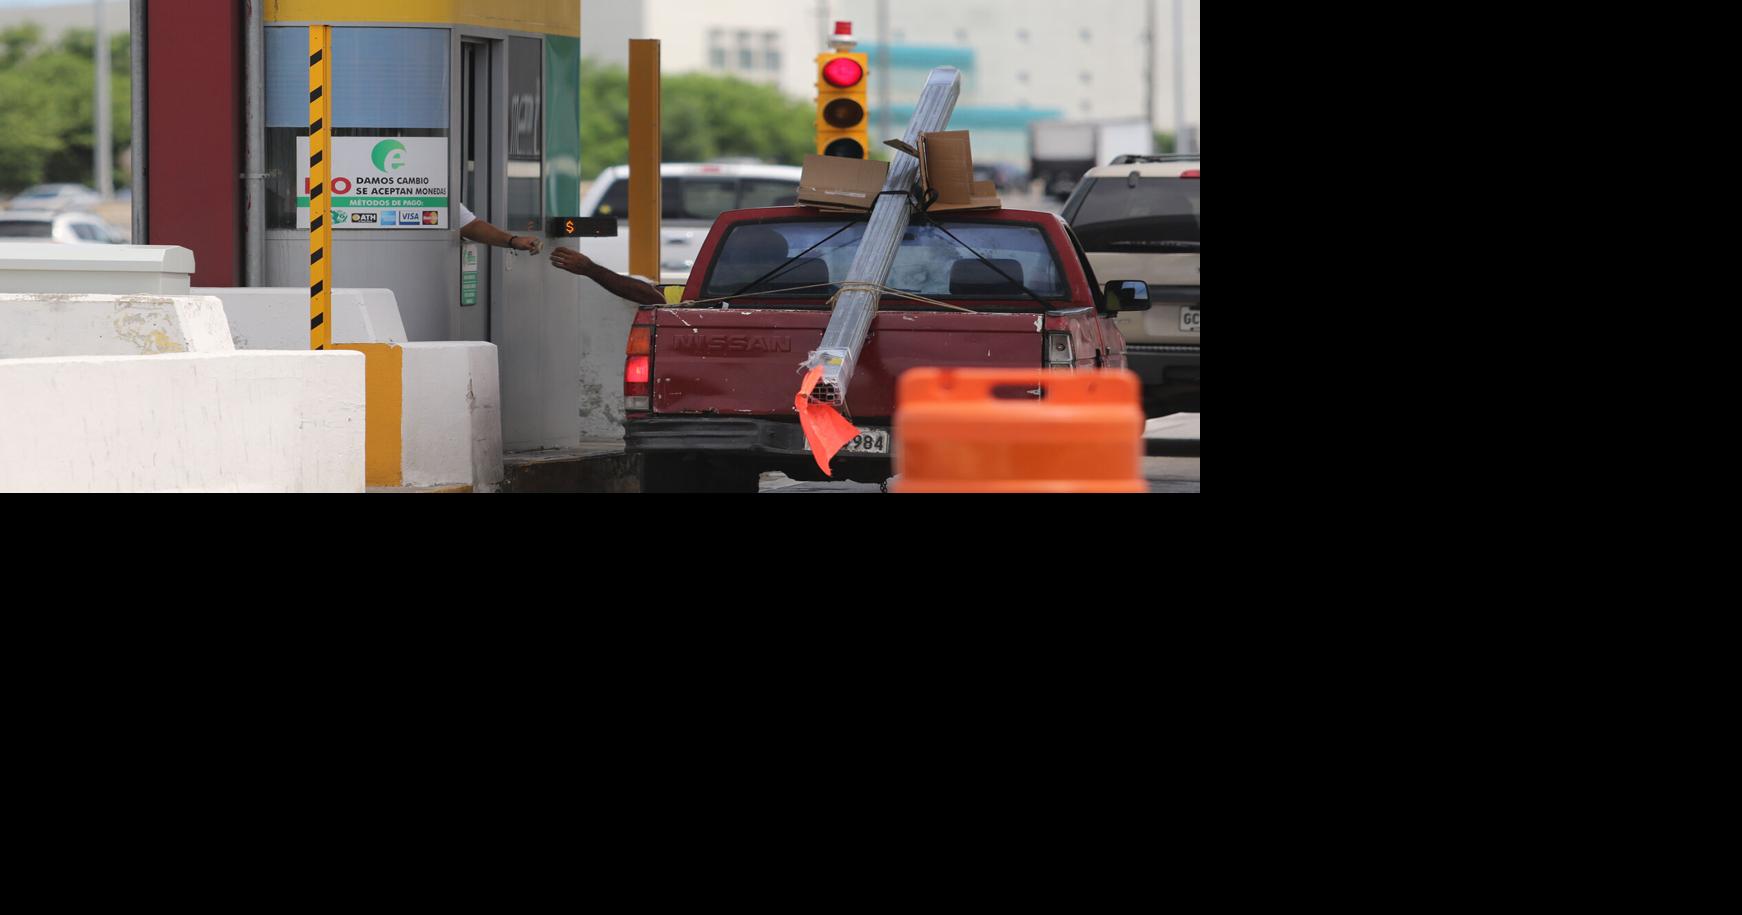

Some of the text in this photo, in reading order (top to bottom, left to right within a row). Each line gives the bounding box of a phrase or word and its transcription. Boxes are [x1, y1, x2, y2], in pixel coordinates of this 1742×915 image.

[356, 177, 429, 185] DAMOS CAMBIO
[356, 187, 447, 196] SE ACEPTAN MONEDAS
[349, 199, 390, 207] MÉTODOS
[402, 212, 420, 221] VISA
[565, 220, 575, 234] $
[673, 335, 792, 353] NISSAN
